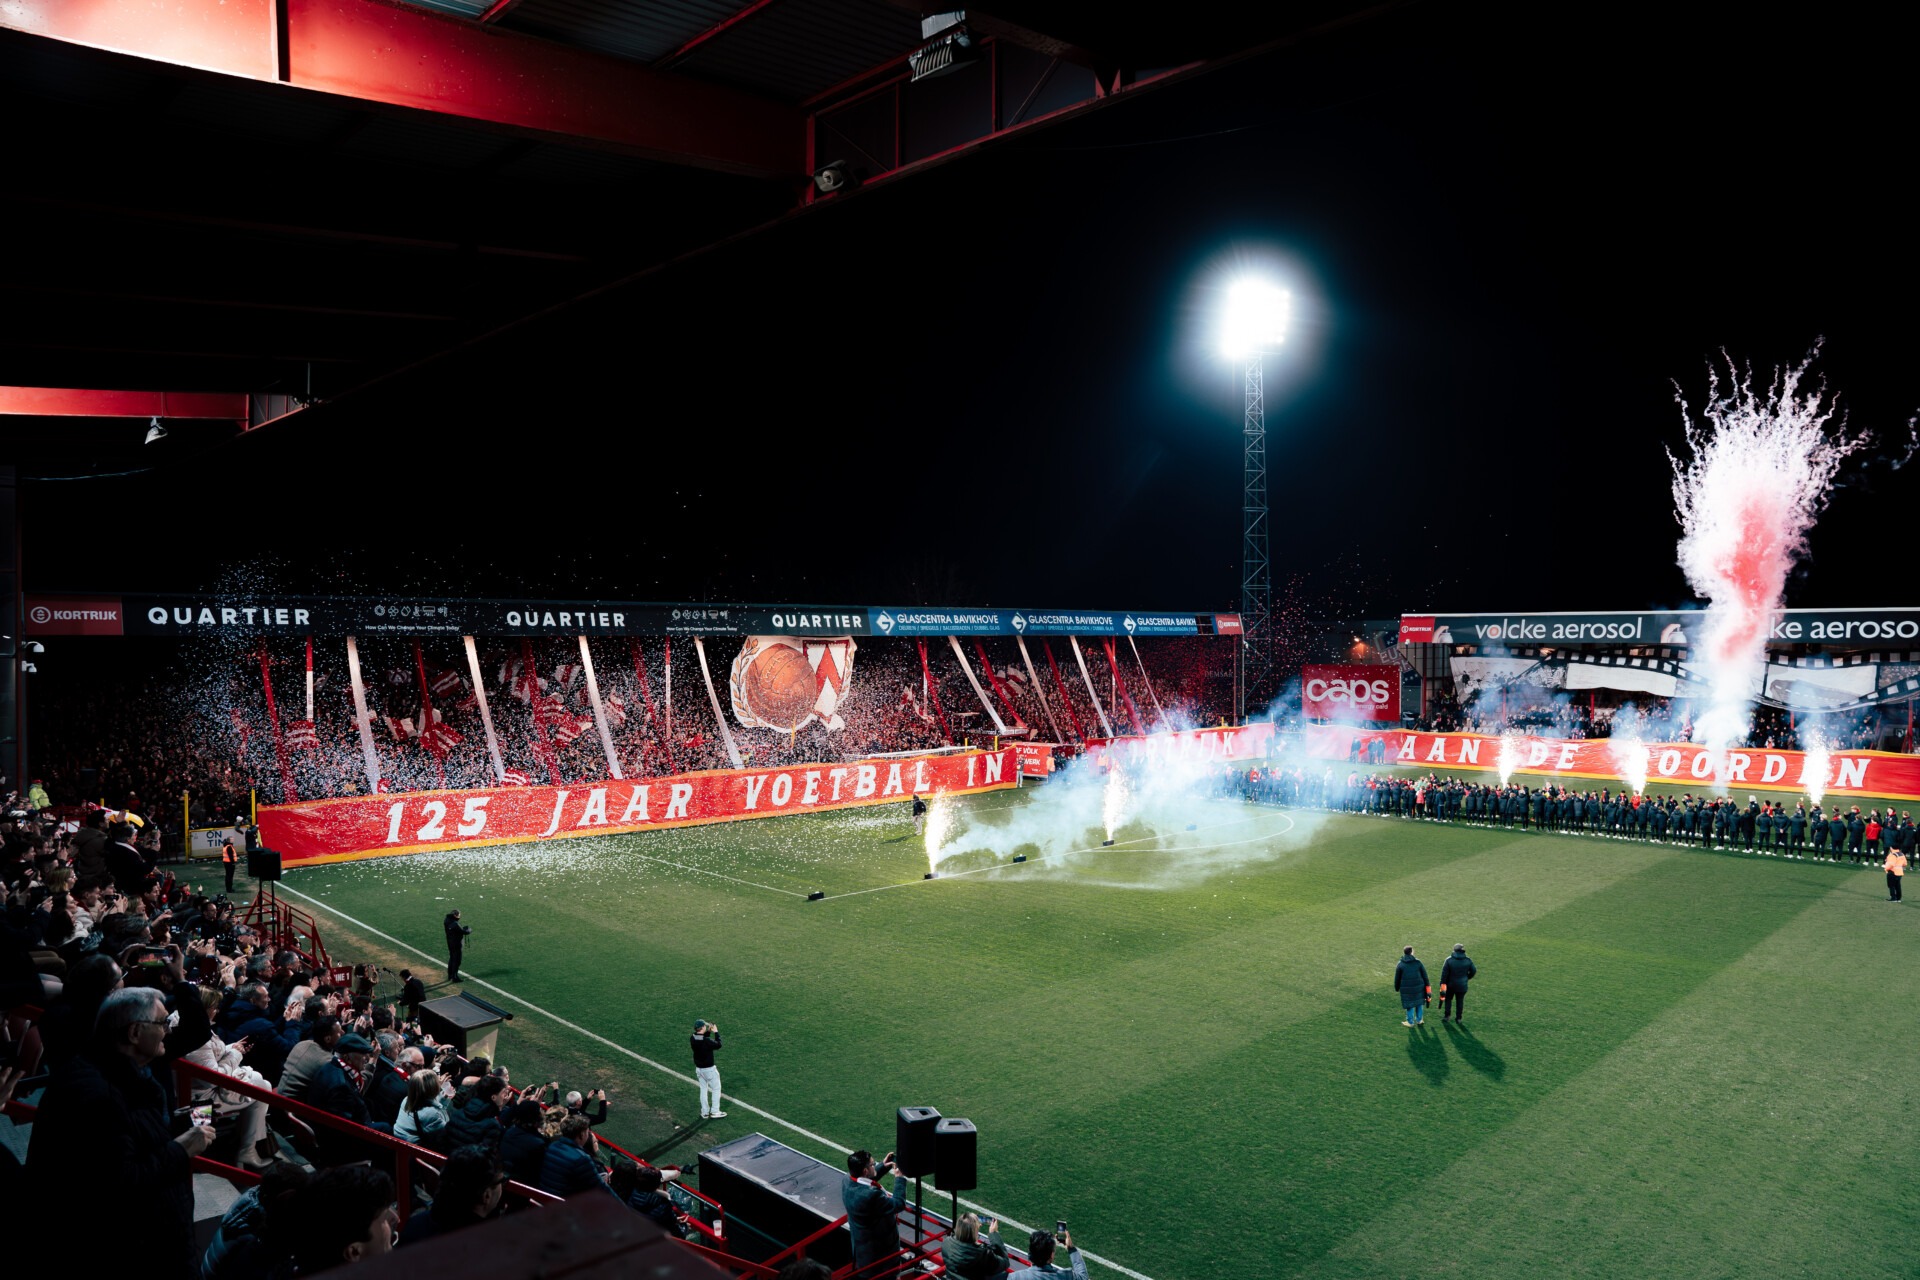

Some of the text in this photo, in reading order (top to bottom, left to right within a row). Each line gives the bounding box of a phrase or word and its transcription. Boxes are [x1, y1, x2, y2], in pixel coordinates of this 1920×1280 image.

[53, 609, 117, 621] KORTRIJK
[148, 606, 310, 626] QUARTIER
[506, 611, 626, 627] QUARTIER
[771, 614, 863, 628] QUARTIER
[897, 614, 999, 624] GLASCENTRA BAVIKHOVE
[1028, 615, 1113, 625] GLASCENTRA BAVIKHOVE
[1137, 618, 1176, 626] GLASCENTRA
[1475, 617, 1642, 639] volcke aerosol
[1306, 678, 1390, 709] caps
[1397, 735, 1871, 788] AAN DE OORDN
[384, 753, 1005, 844] 125 JAAR VOETBAL IN
[206, 830, 222, 839] ON
[207, 839, 226, 848] TIM
